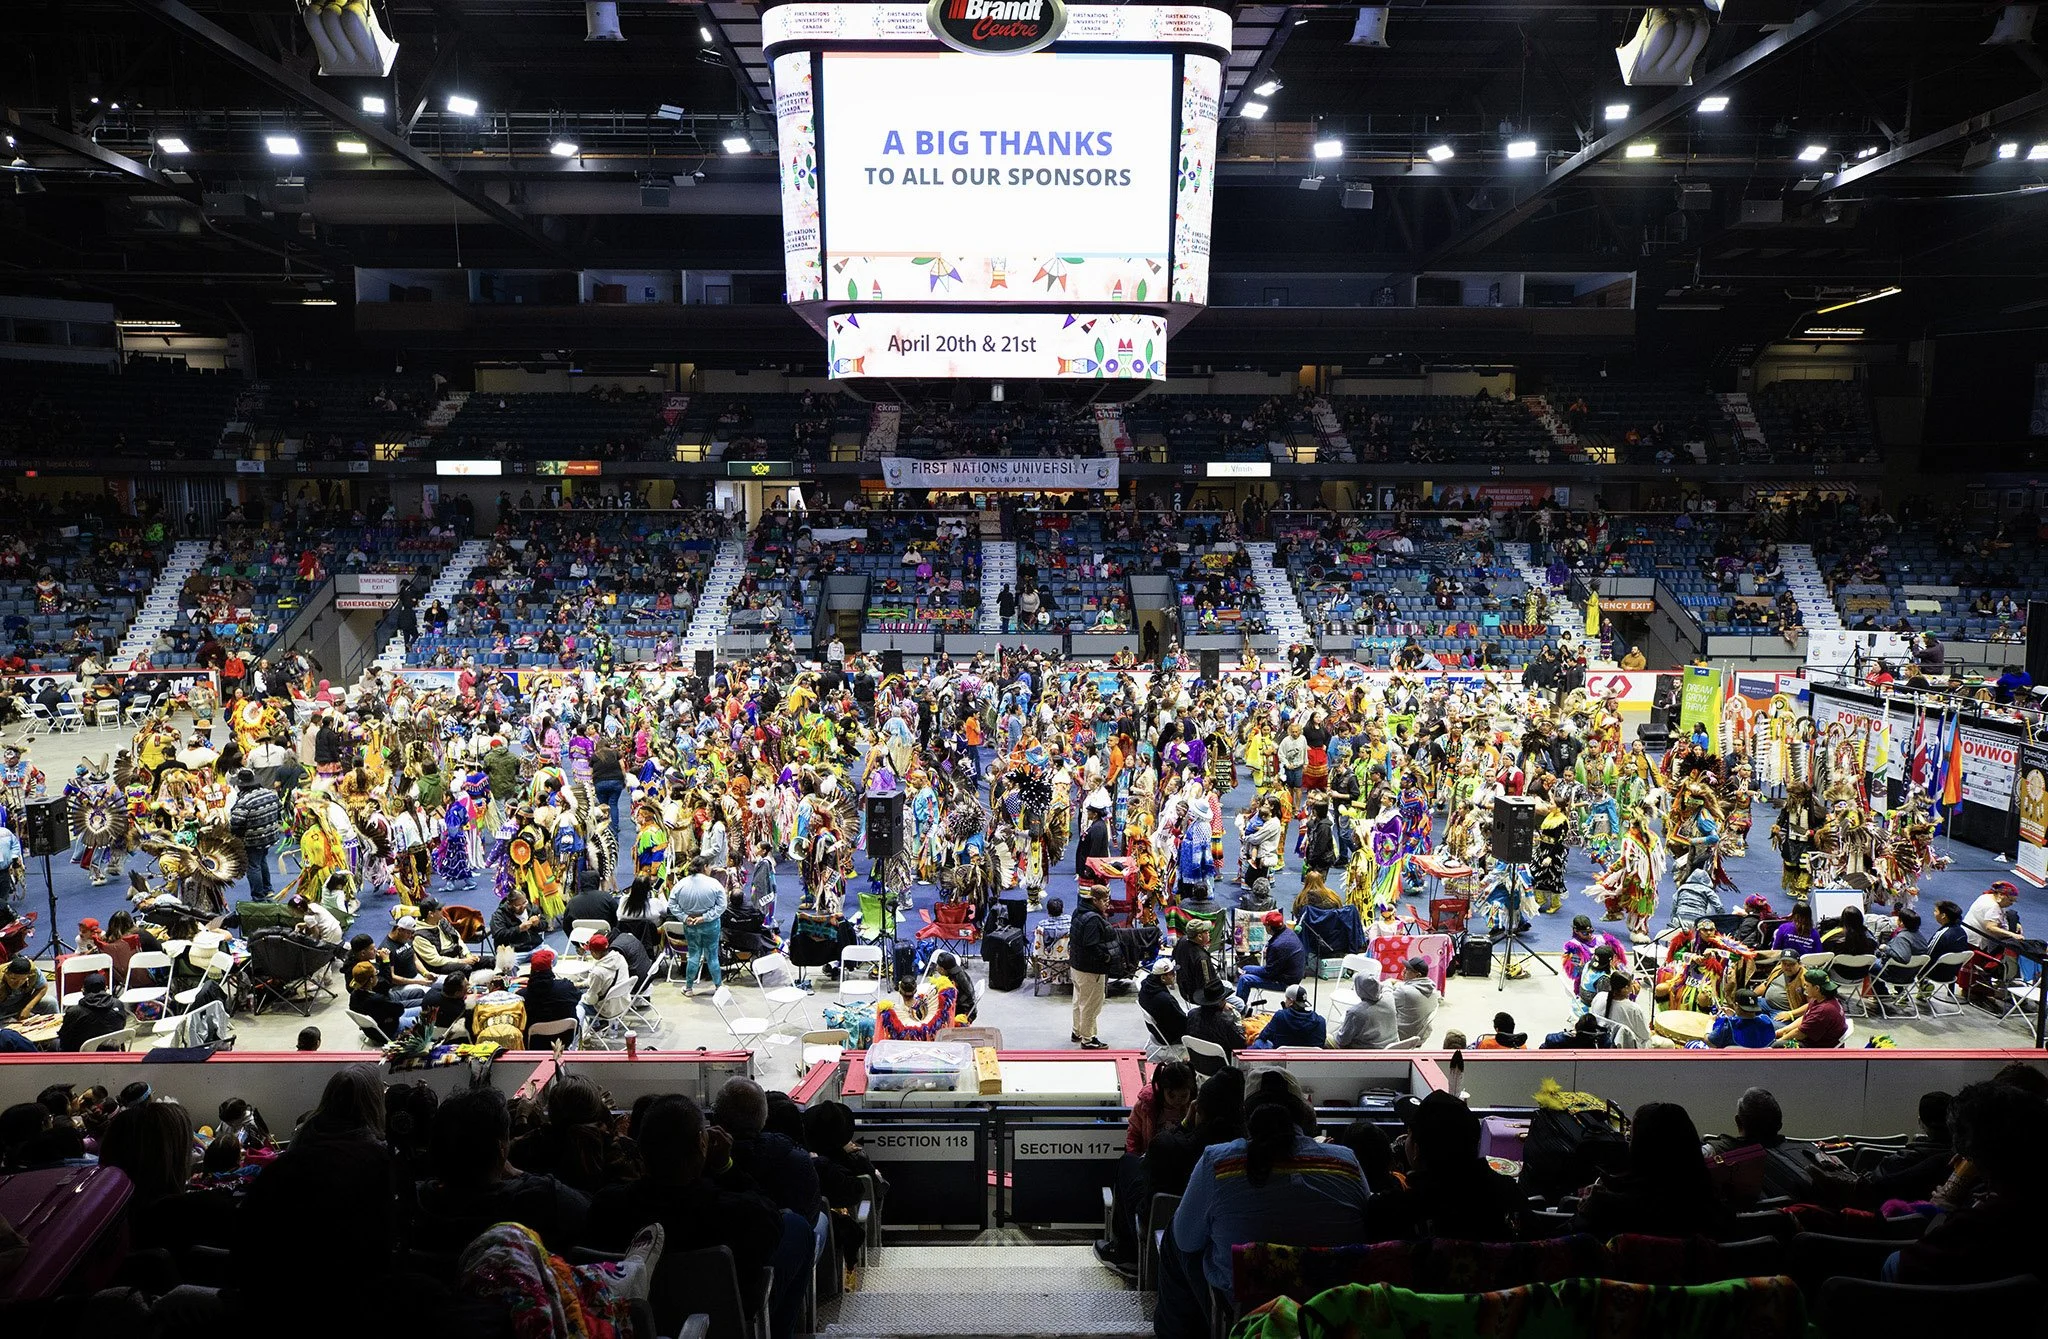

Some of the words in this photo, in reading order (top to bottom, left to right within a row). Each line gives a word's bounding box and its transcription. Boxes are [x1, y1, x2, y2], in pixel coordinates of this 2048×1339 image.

[964, 0, 1043, 21] Brandt
[971, 15, 1038, 40] Centre
[883, 130, 905, 155] A
[916, 130, 969, 155] BIG
[980, 131, 1112, 156] THANKS
[864, 167, 895, 185] TO
[902, 167, 944, 185] ALL
[951, 167, 1001, 186] OUR
[1008, 168, 1131, 186] SPONSORS
[887, 334, 930, 356] April
[935, 334, 977, 352] 20th
[982, 335, 996, 352] &
[1001, 335, 1037, 352] 21st
[911, 462, 948, 475] FIRST
[952, 461, 1008, 475] NATIONS
[1013, 461, 1089, 475] UNIVERSIY
[1599, 602, 1628, 610] GENCY
[1630, 602, 1652, 610] EXIT
[1686, 683, 1713, 695] DREAM
[1685, 693, 1710, 704] GROW
[1684, 702, 1708, 712] THRIVE
[1983, 739, 2018, 752] CELEBRATIO
[1961, 741, 2019, 766] OWWO
[877, 1136, 941, 1148] SECTION
[945, 1136, 968, 1147] 118
[1020, 1143, 1083, 1155] SECTION
[1088, 1143, 1110, 1154] 117
